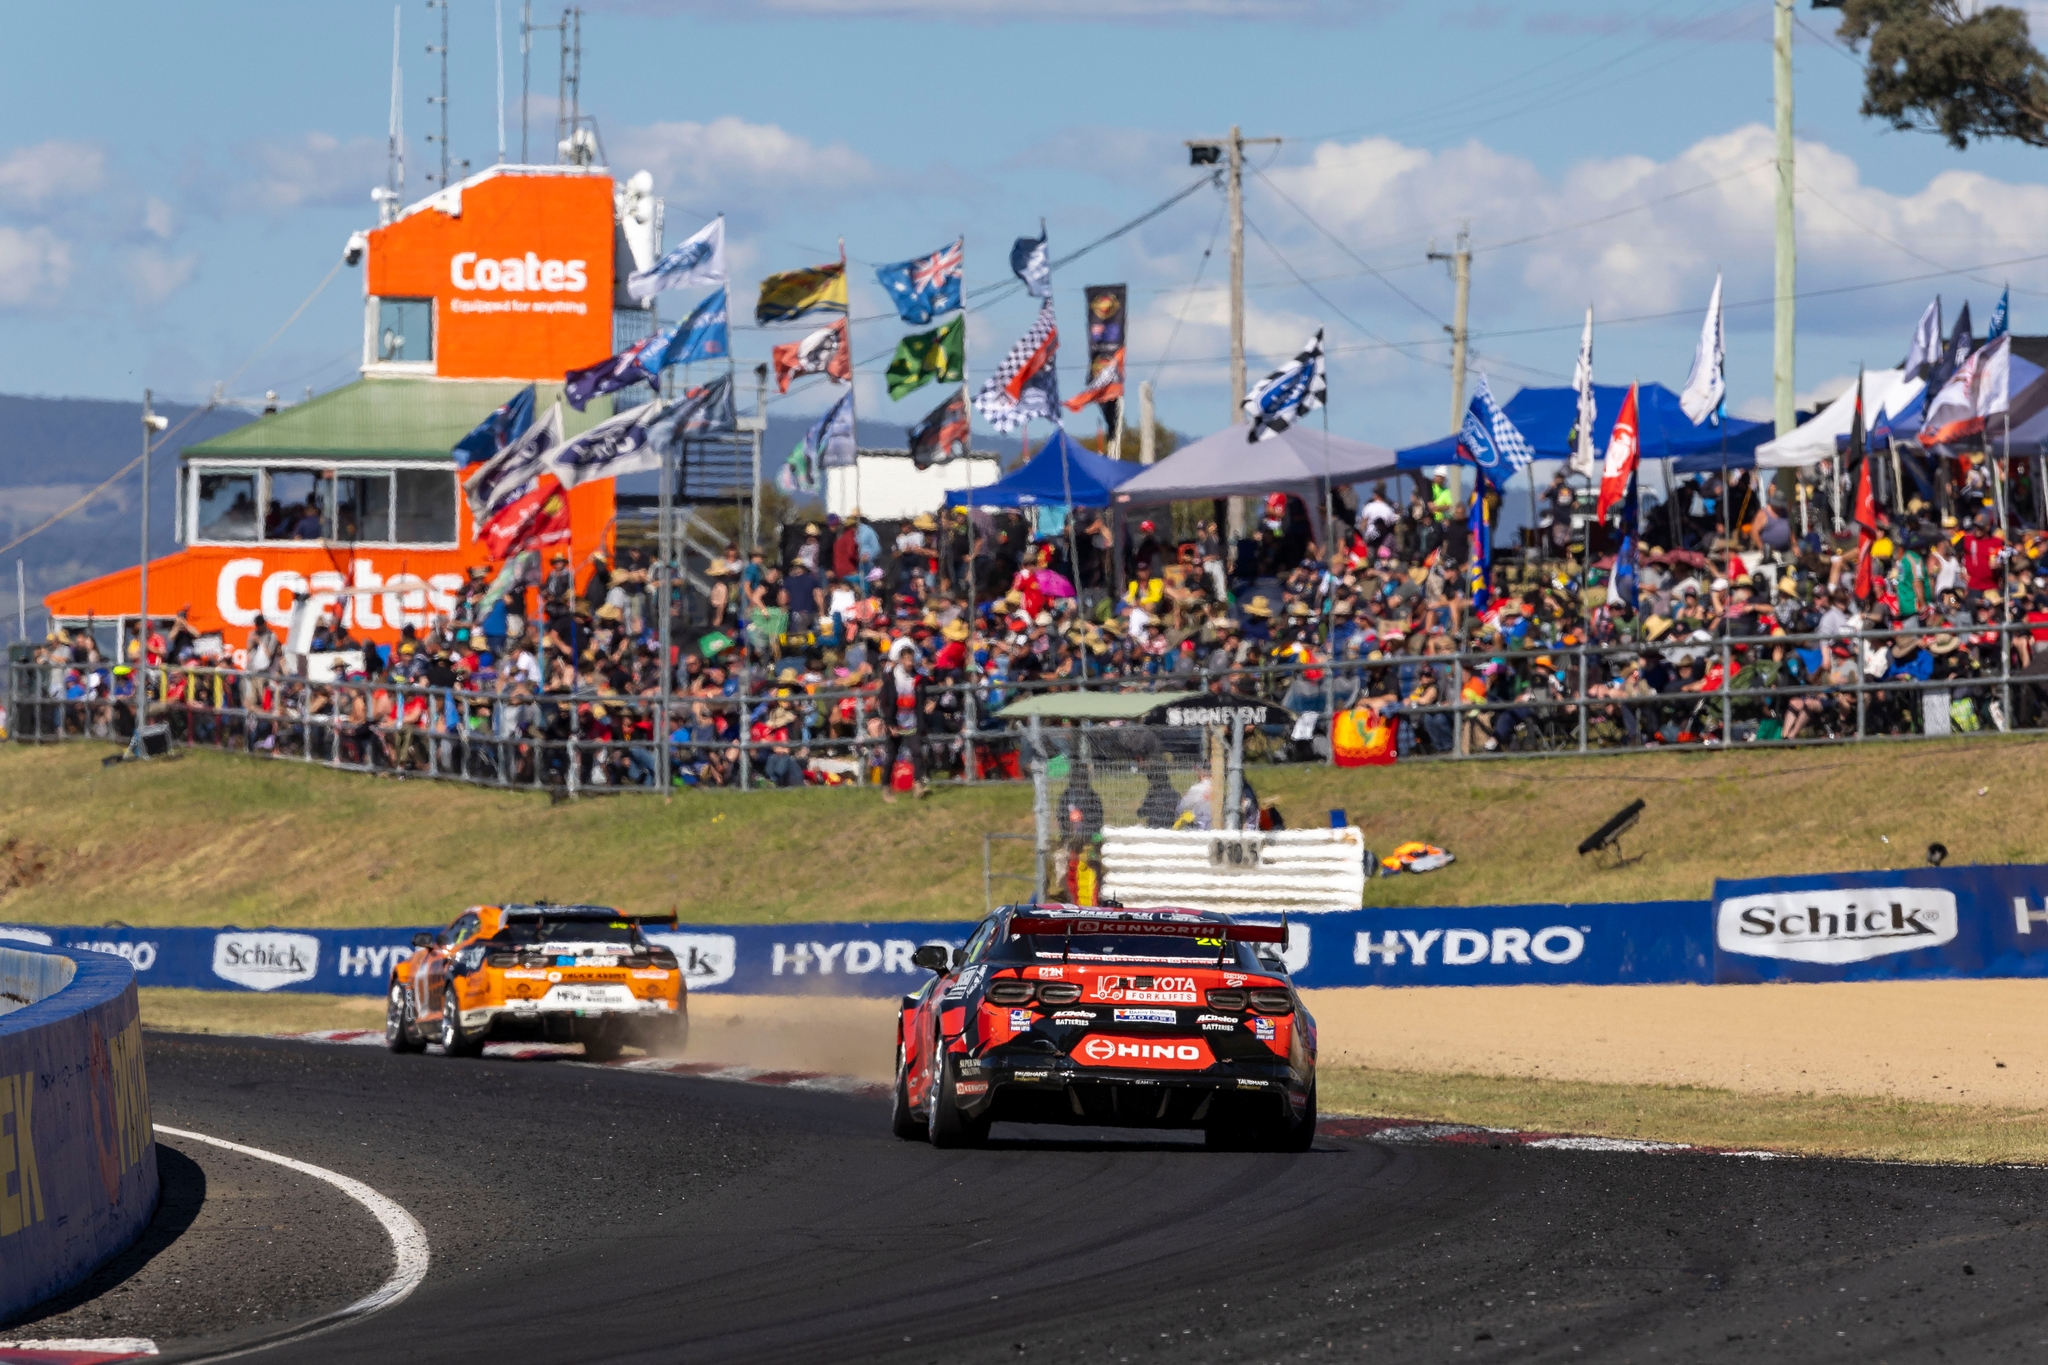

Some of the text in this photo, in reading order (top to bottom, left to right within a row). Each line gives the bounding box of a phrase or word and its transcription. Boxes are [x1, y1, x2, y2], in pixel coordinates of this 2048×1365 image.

[450, 251, 588, 292] Coates
[216, 557, 463, 630] Coates
[1102, 923, 1215, 935] KENWORTH
[1223, 973, 1248, 981] SEIKO
[1132, 992, 1192, 1001] FORKLIFTS
[1053, 1010, 1097, 1018] ACDelco
[1196, 1015, 1239, 1023] ACDelco
[1117, 1043, 1200, 1060] HINO
